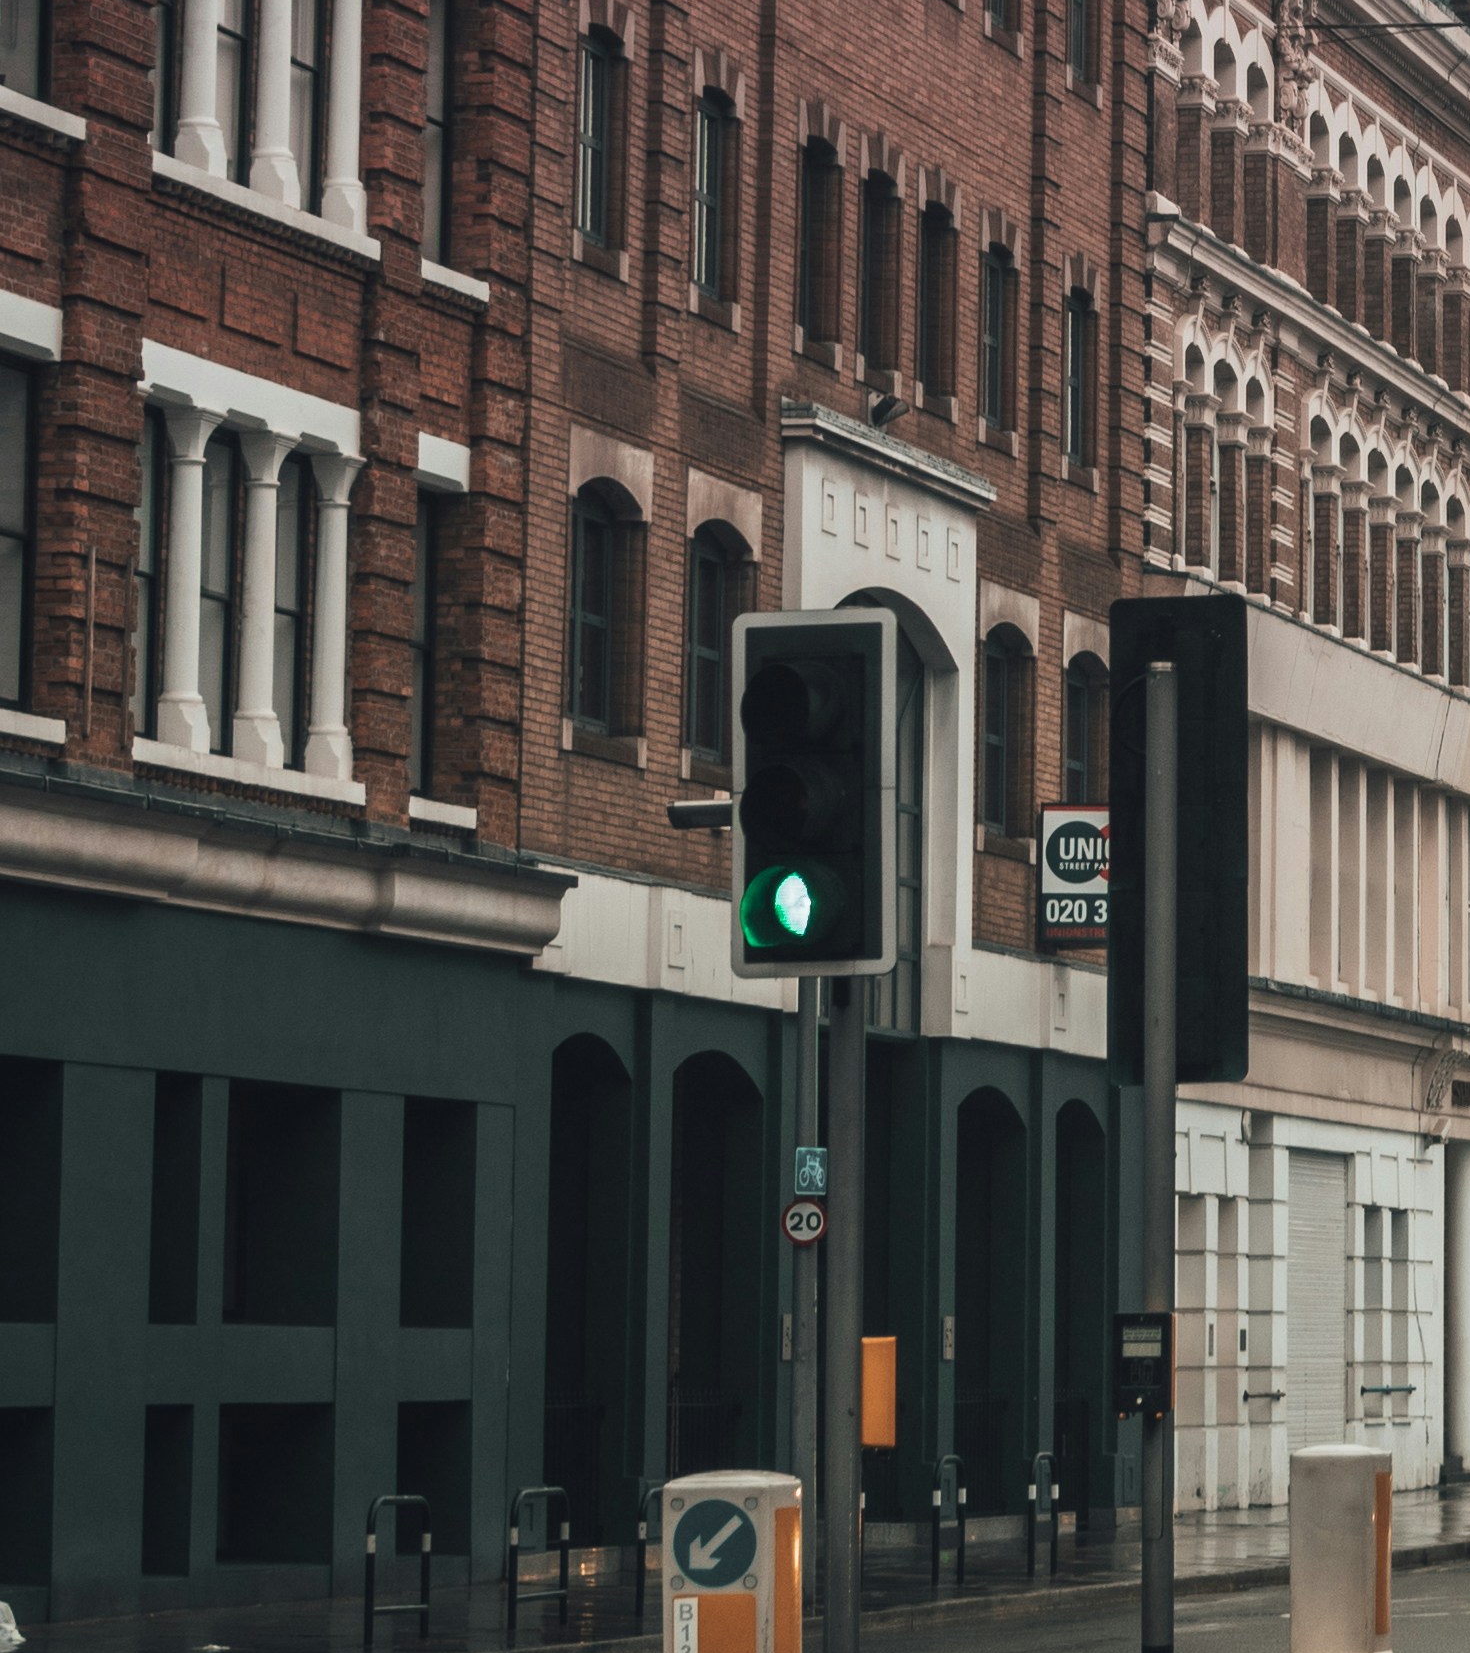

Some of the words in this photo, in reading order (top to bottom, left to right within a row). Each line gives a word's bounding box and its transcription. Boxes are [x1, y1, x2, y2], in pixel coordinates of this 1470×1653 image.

[1059, 861, 1090, 871] STREET
[1045, 899, 1087, 923] 020
[1093, 899, 1108, 923] 3
[789, 1212, 821, 1232] 20
